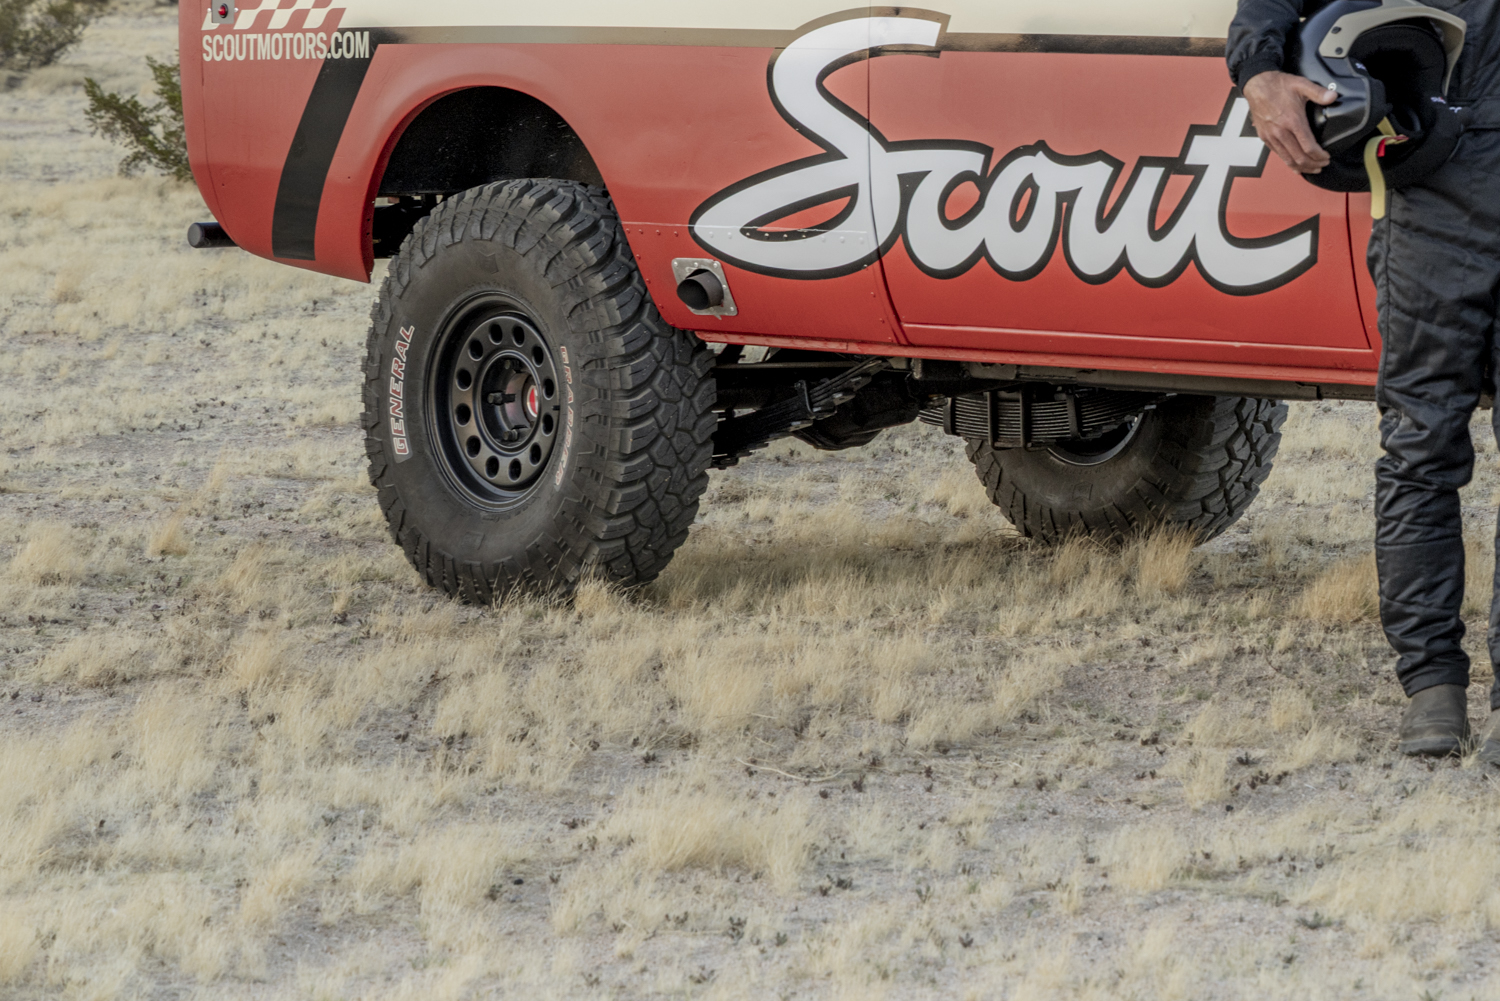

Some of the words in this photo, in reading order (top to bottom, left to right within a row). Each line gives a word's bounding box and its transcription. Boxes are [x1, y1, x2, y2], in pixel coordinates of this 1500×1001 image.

[202, 30, 370, 62] SCOUTMOTORS.COM
[688, 6, 1320, 297] Scout
[389, 325, 415, 455] GENERAL
